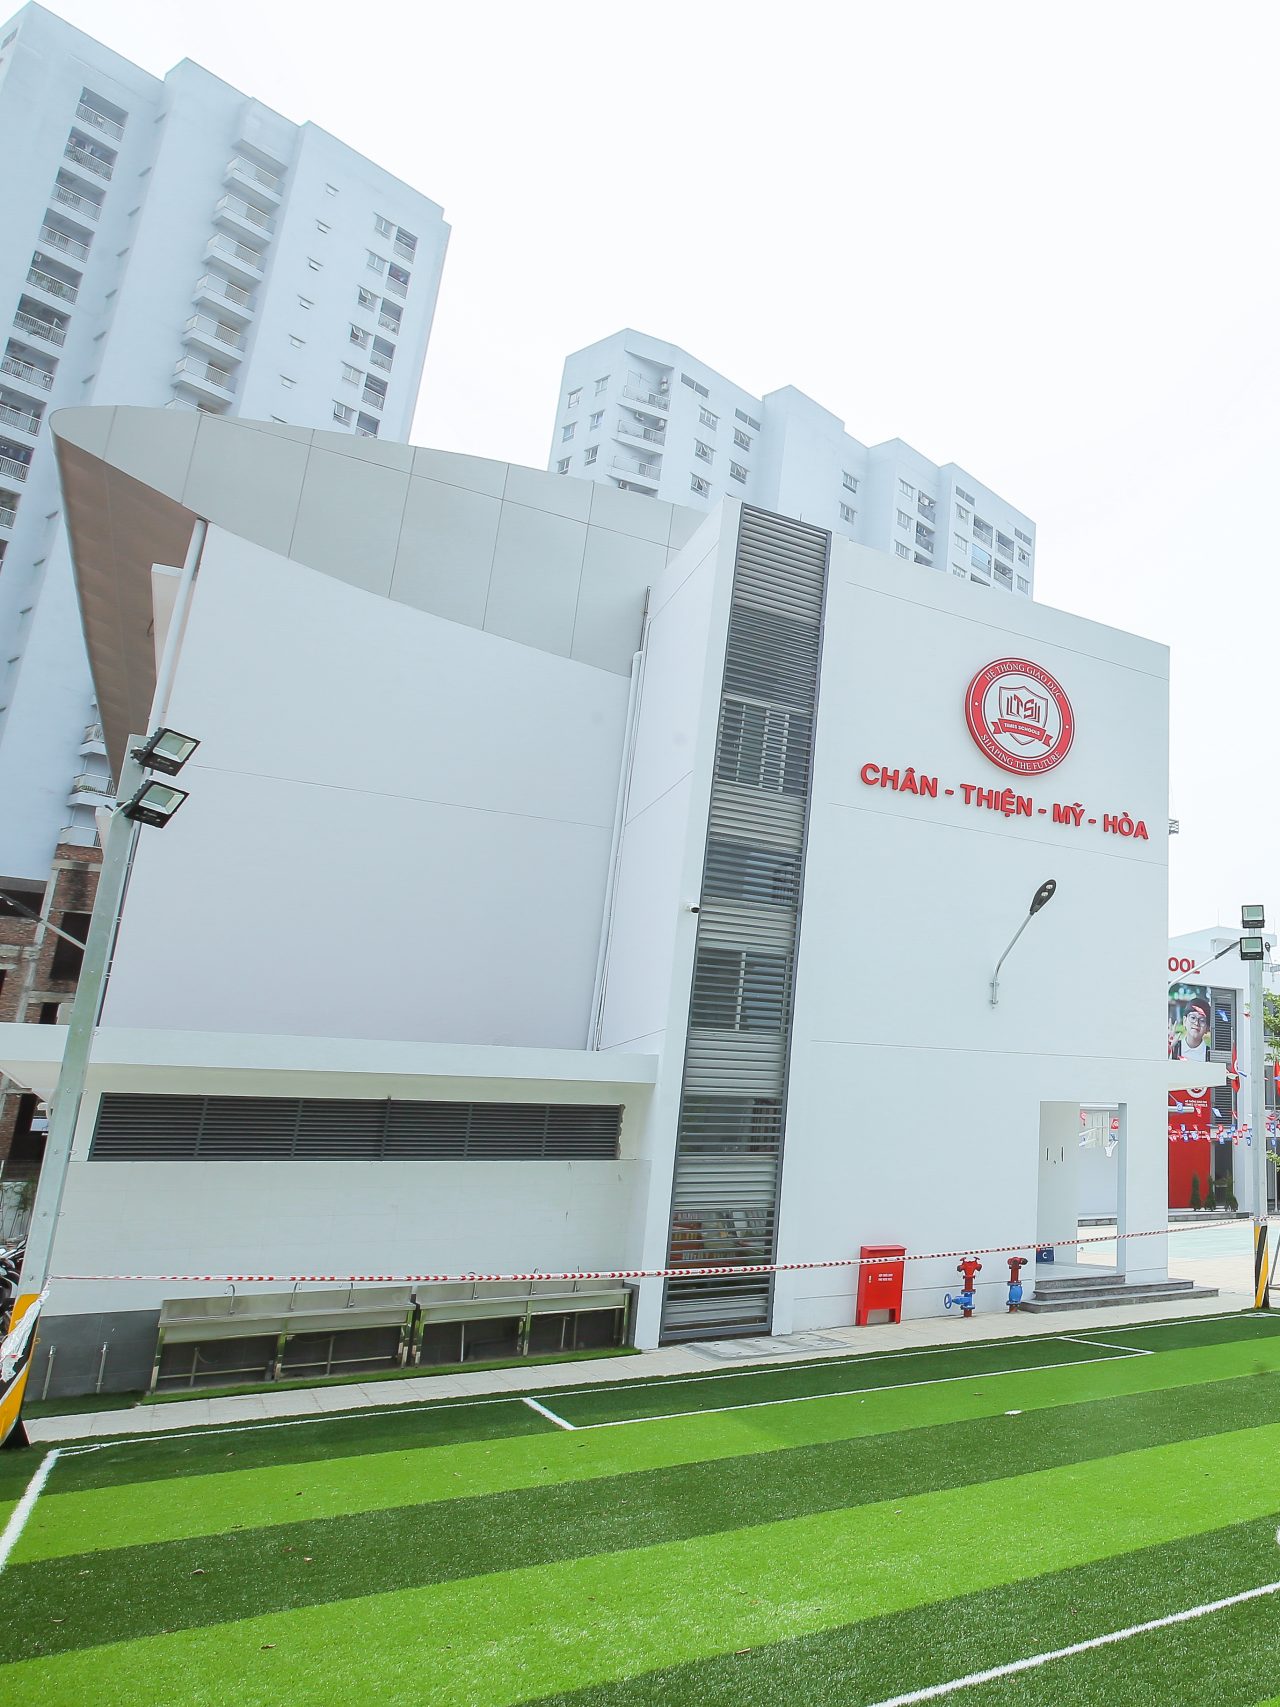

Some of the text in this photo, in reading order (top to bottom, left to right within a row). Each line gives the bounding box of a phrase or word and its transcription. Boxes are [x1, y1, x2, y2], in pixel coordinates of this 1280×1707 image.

[981, 734, 1062, 771] SHAPING THE FUTURE
[860, 763, 938, 798] CHÂN
[960, 783, 1033, 818] THIỆN
[1052, 802, 1086, 827] MỸ
[1103, 812, 1149, 840] HÒA
